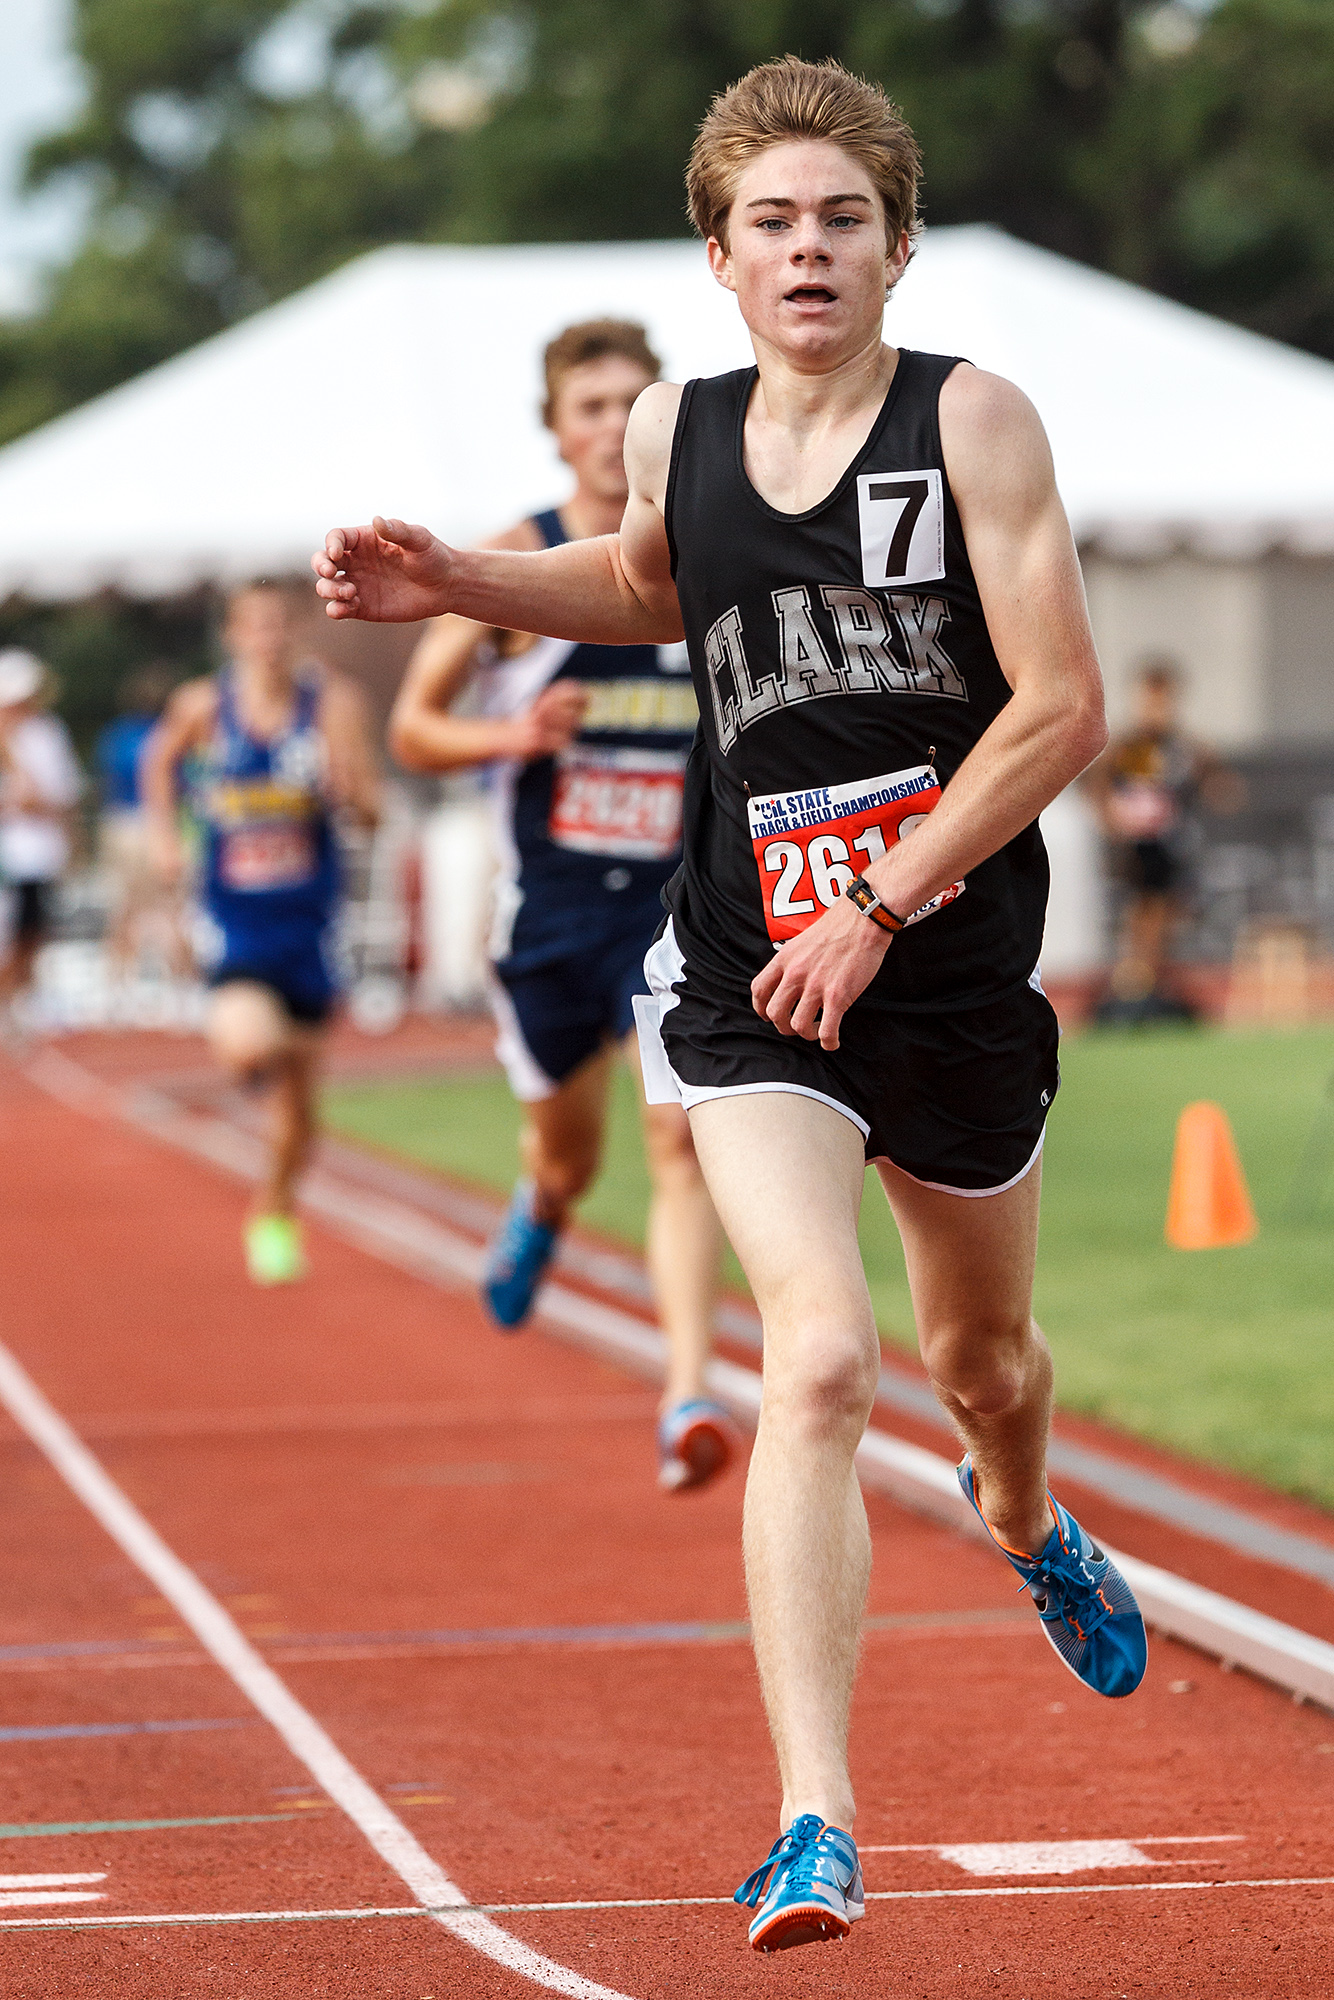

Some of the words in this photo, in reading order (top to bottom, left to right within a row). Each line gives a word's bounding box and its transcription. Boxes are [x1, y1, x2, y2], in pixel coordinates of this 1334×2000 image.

[868, 479, 929, 578] 7
[703, 584, 969, 757] CLARK
[752, 816, 792, 838] TRACK
[800, 806, 833, 827] FIELD
[833, 773, 936, 819] CHAMPIONSHIPS
[786, 787, 832, 814] STATE
